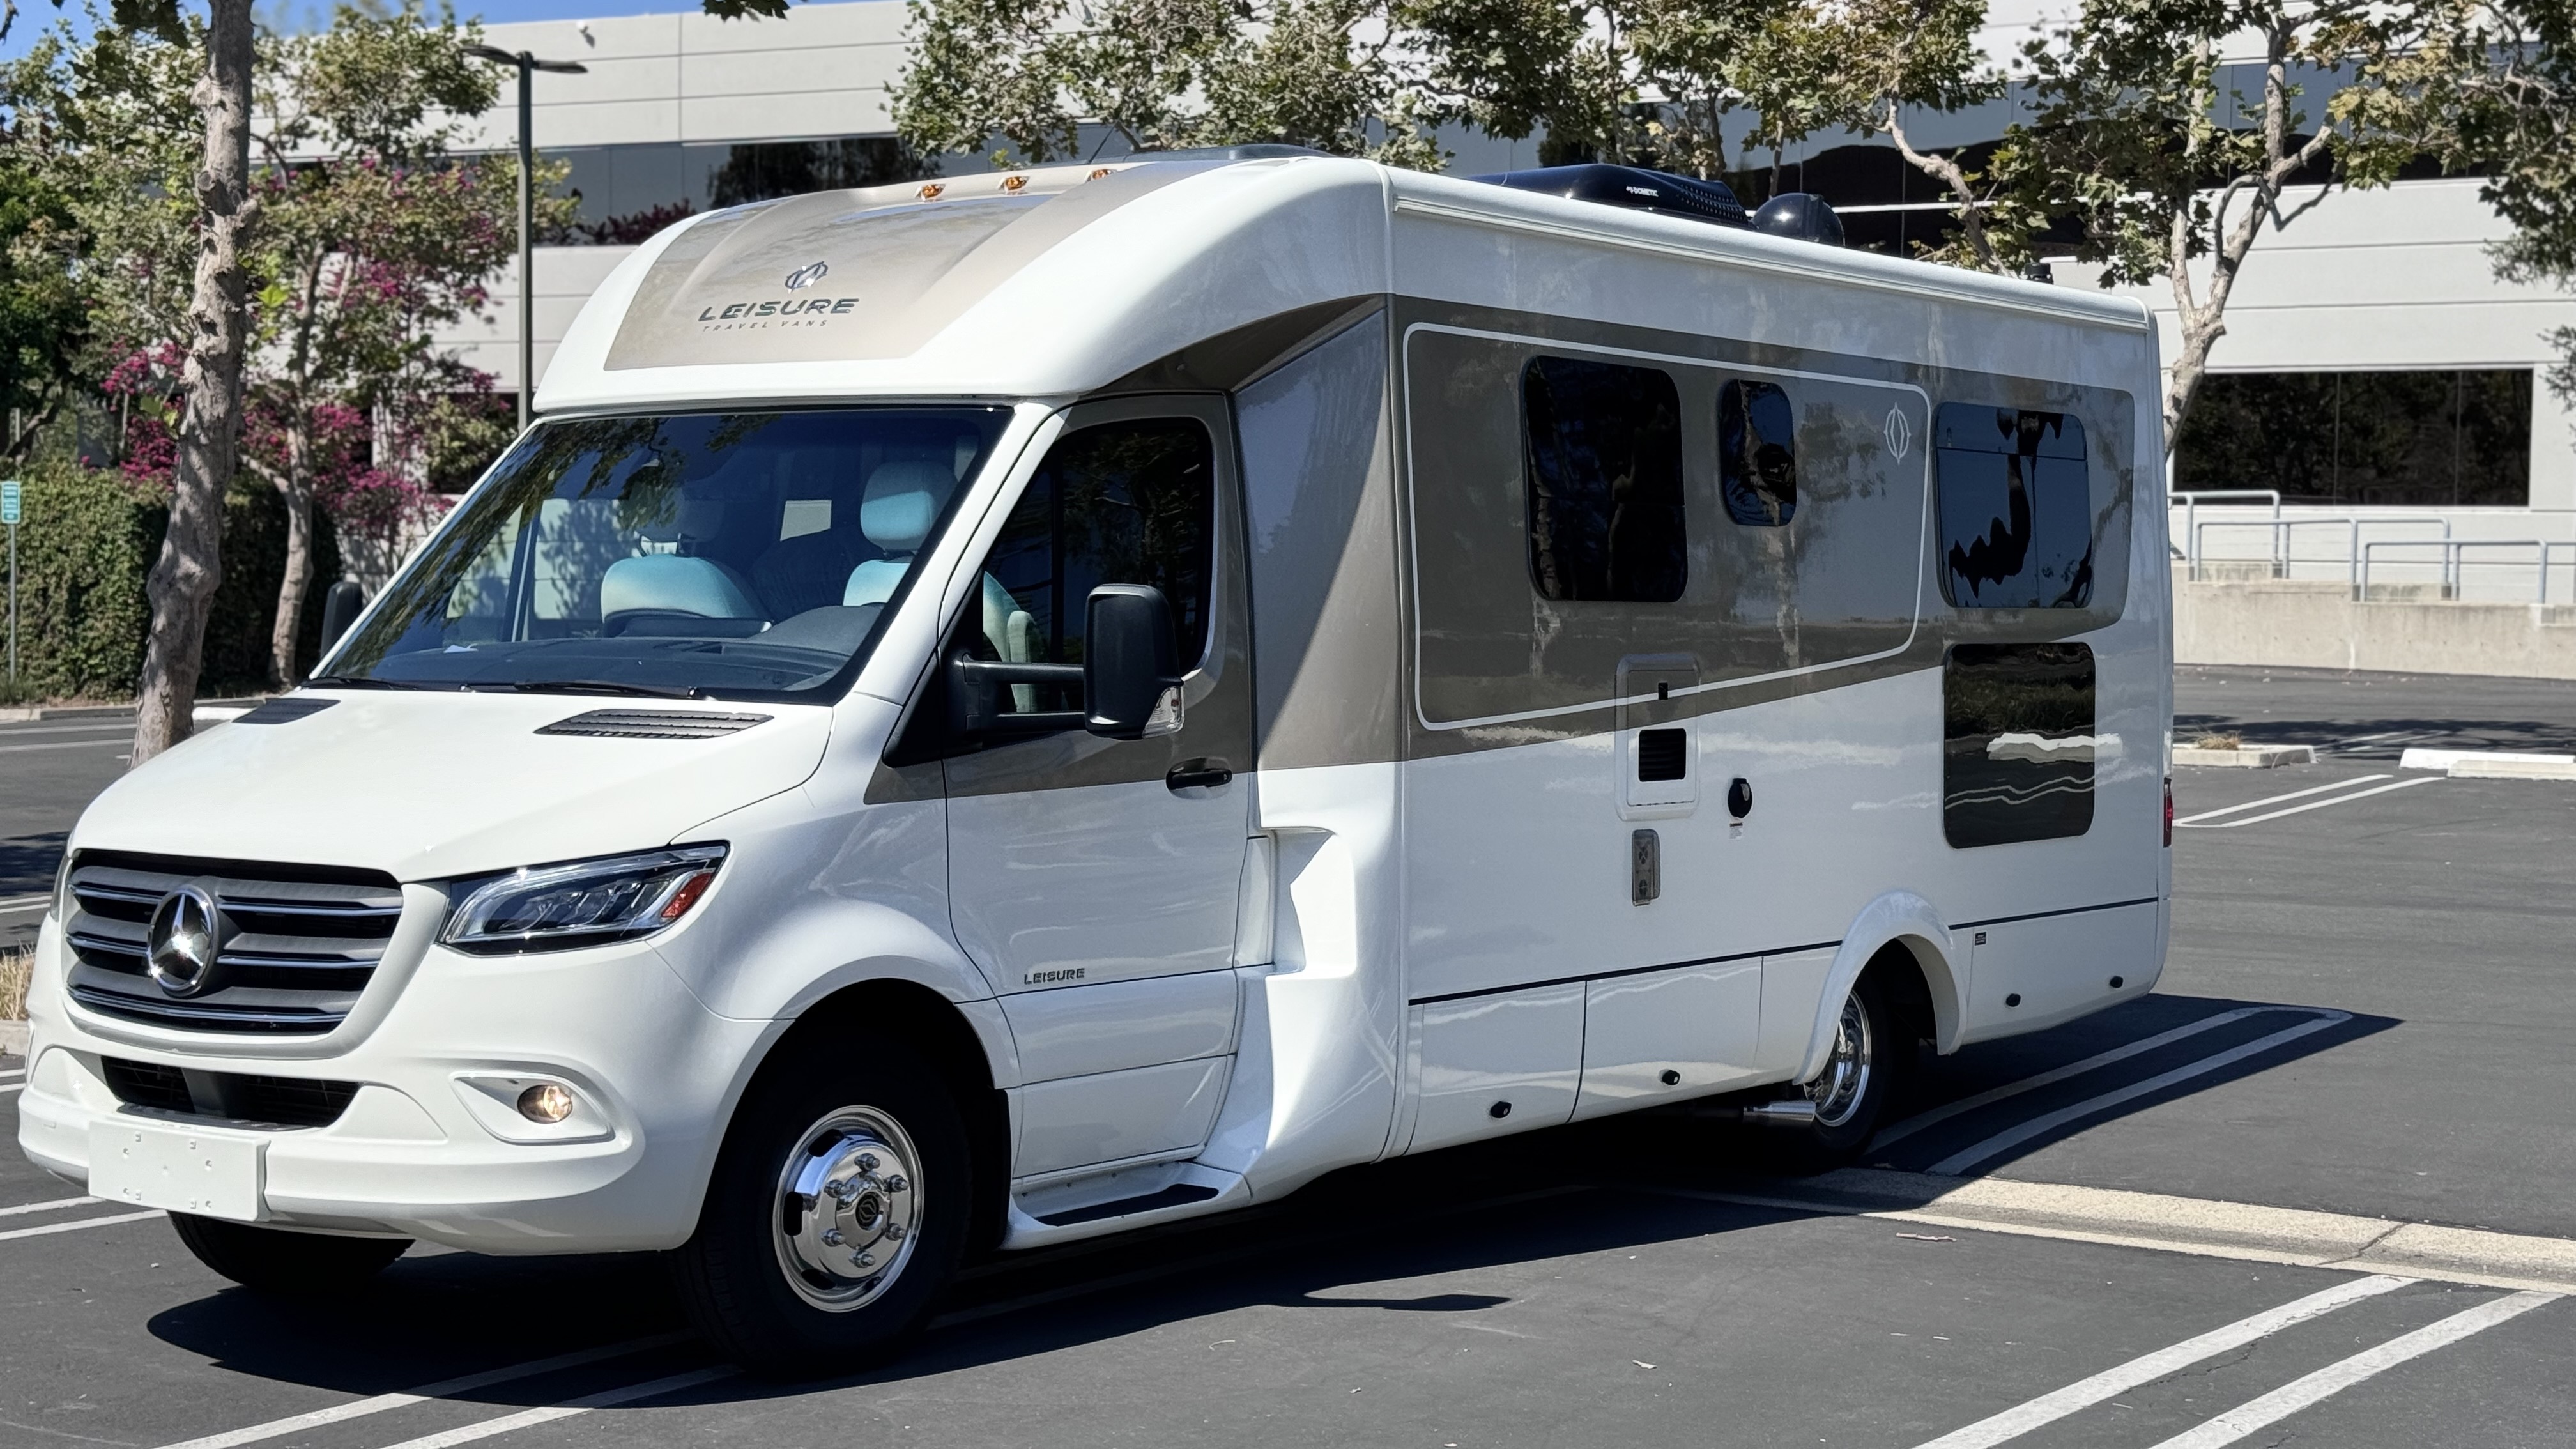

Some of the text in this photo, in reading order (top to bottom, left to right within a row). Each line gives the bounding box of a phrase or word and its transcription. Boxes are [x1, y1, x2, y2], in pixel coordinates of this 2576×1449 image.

[698, 298, 859, 321] LEISURE
[703, 322, 769, 332] TRAVEL
[1024, 968, 1085, 985] LEISURE
